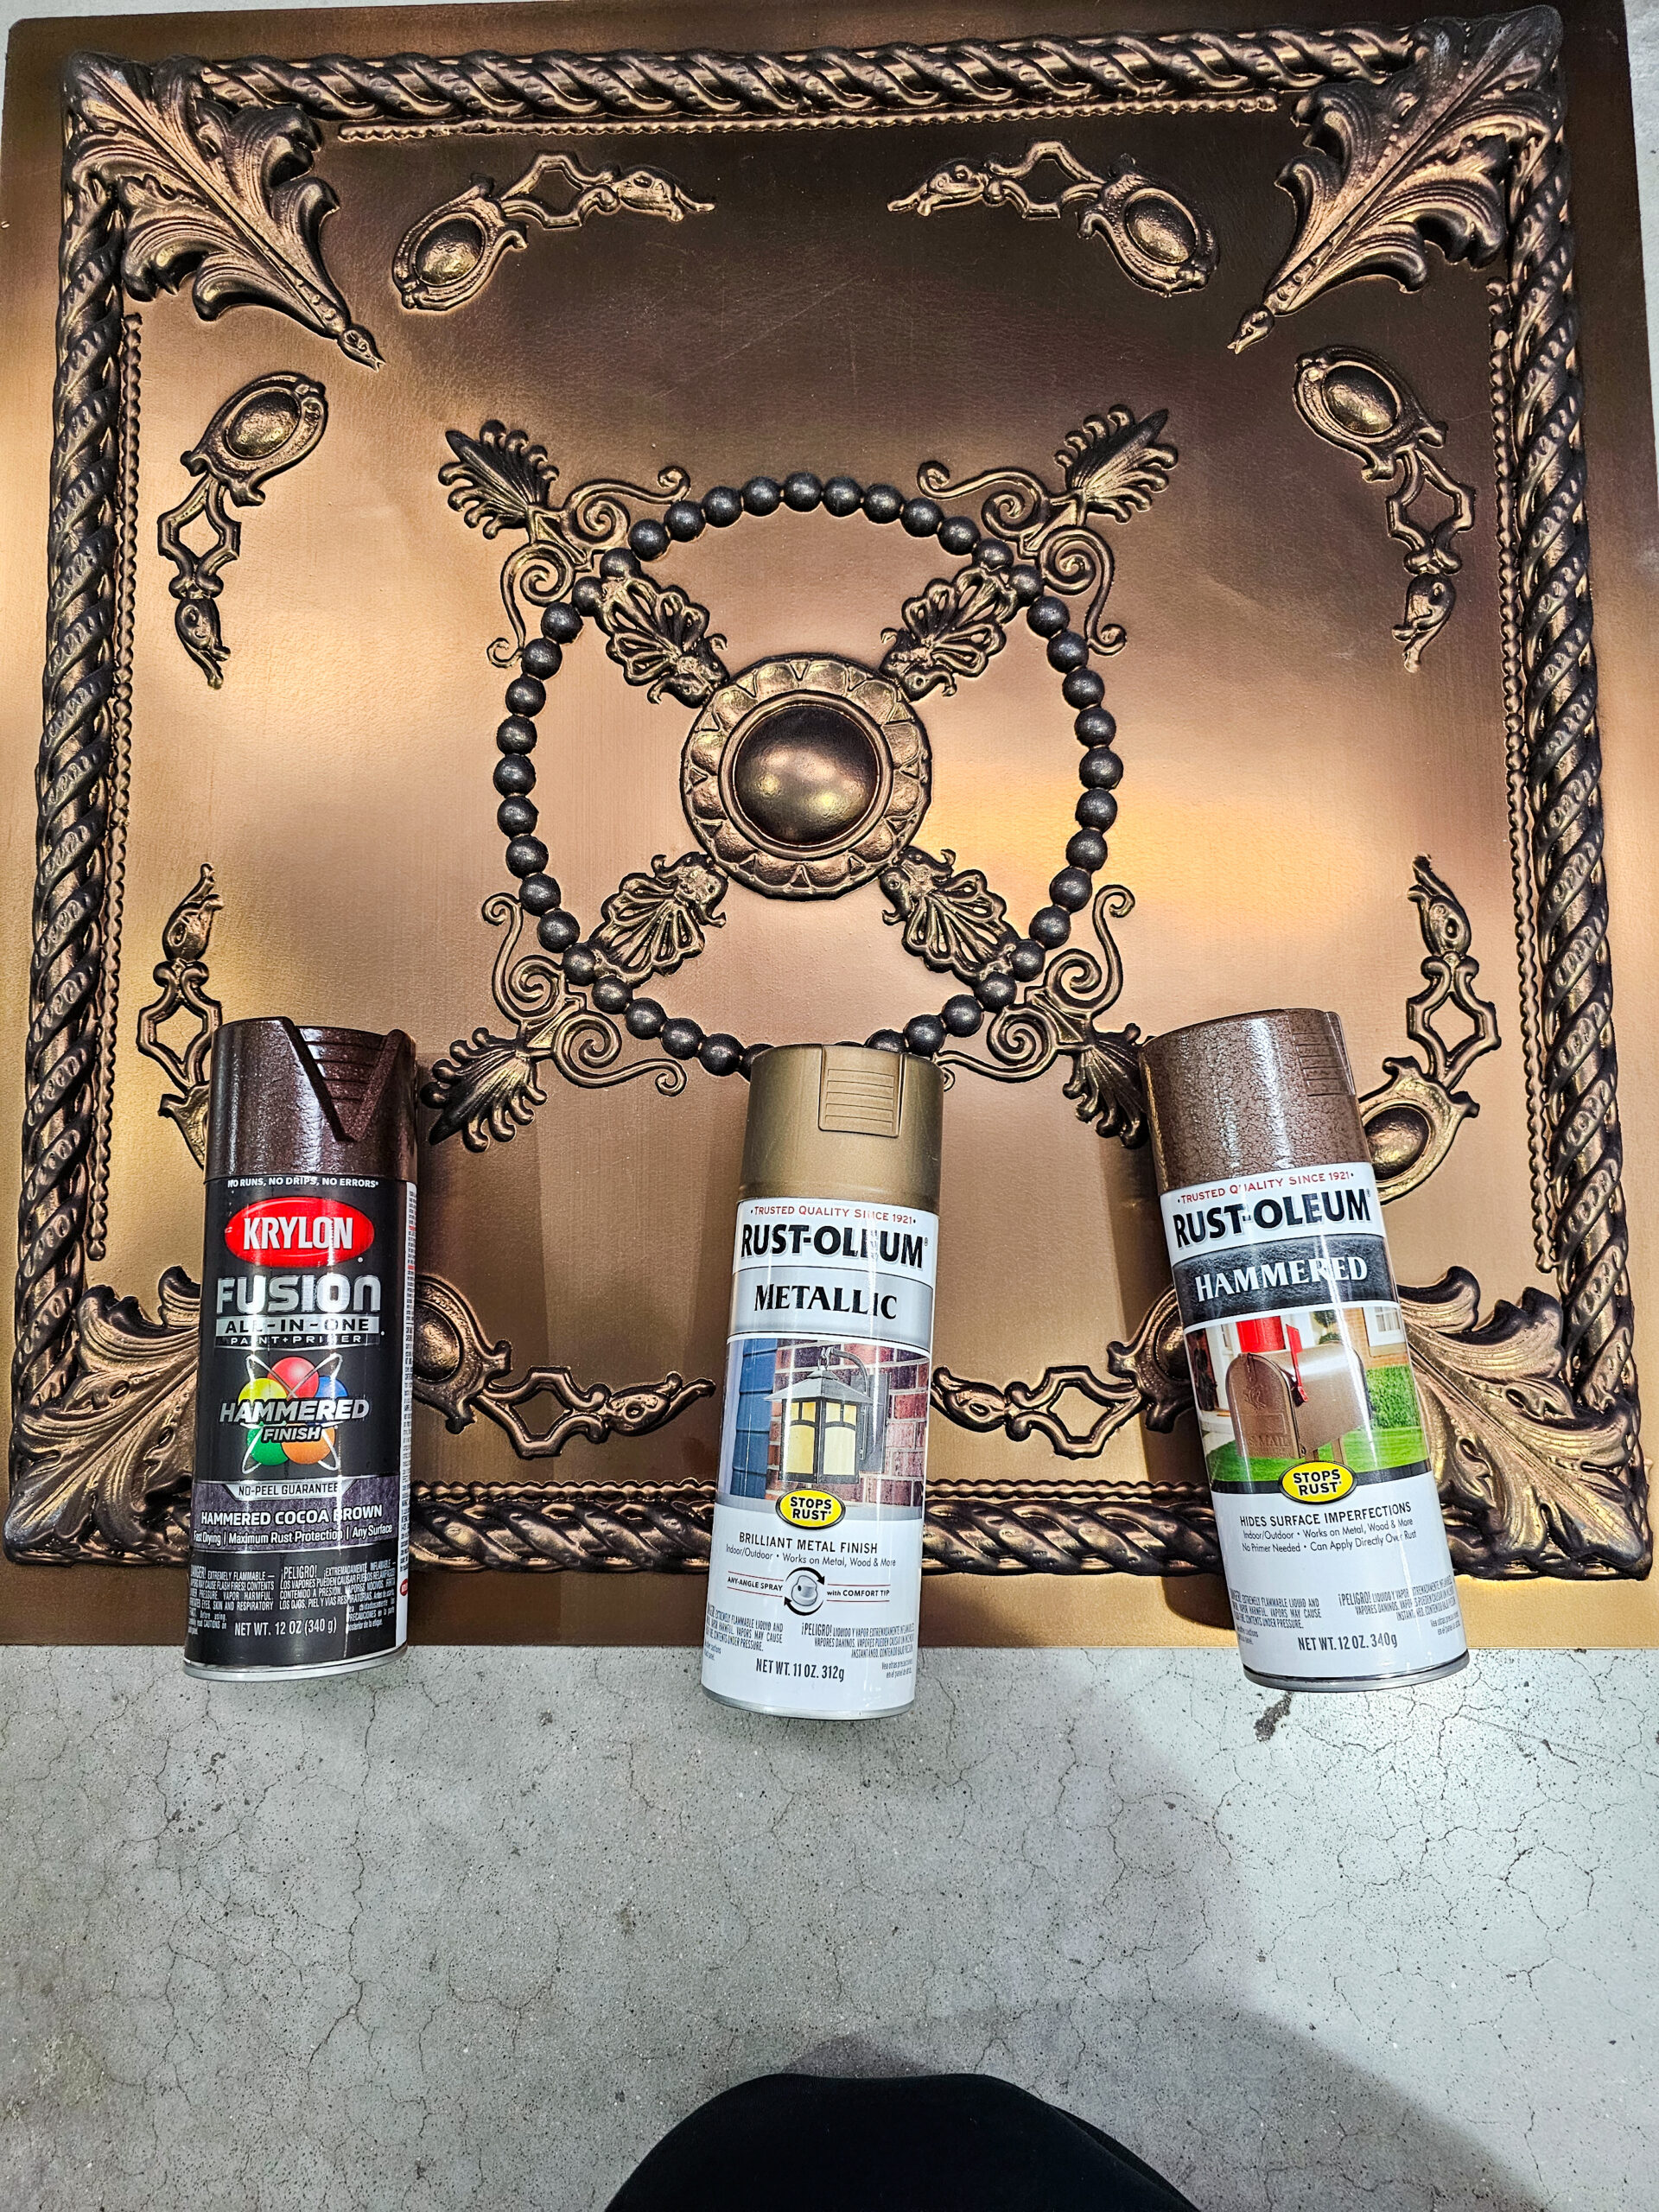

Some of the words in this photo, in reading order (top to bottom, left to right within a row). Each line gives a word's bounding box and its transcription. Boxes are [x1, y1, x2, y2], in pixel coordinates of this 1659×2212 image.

[227, 1179, 238, 1188] NO
[240, 1178, 266, 1187] RUNS,
[286, 1176, 320, 1185] DRIPS,
[1180, 1188, 1225, 1203] TRUSTED
[1289, 1173, 1325, 1185] SINCE
[1329, 1171, 1350, 1181] 1921
[754, 1206, 795, 1215] TRUSTED
[798, 1206, 850, 1217] QUALITY
[893, 1213, 912, 1224] 1921
[1173, 1189, 1370, 1248] RUST-OLEUM
[244, 1216, 353, 1249] KRYLON
[1194, 1256, 1367, 1302] HAMMERED
[216, 1274, 380, 1314] FUSION
[753, 1284, 897, 1319] METALLIC
[231, 1336, 361, 1346] PANT+PRIER
[219, 1399, 370, 1423] HAMMERED
[263, 1427, 321, 1441] FINISH
[1293, 1469, 1340, 1484] STOPS
[238, 1484, 278, 1497] NO-PEEL
[282, 1483, 337, 1495] GUARANTEE
[1298, 1481, 1338, 1497] RUST
[790, 1497, 831, 1510] STOPS
[201, 1510, 271, 1526] HAMMERED
[274, 1509, 329, 1525] COCOA
[333, 1504, 383, 1522] BROWN
[792, 1509, 826, 1521] RUST
[1239, 1516, 1267, 1528] HIDES
[1270, 1514, 1320, 1527] SURFACE
[1324, 1502, 1412, 1523] IMPERFECTIONS
[194, 1529, 202, 1542] Fast
[202, 1531, 221, 1546] Drying
[228, 1532, 268, 1544] Maximum
[270, 1531, 292, 1543] Rust
[295, 1529, 342, 1543] Protection
[353, 1527, 368, 1540] Any
[368, 1522, 392, 1536] Surface
[1243, 1529, 1294, 1540] Indoor/Outdoor
[1303, 1529, 1327, 1538] Works
[1342, 1524, 1365, 1535] Metal,
[1367, 1521, 1389, 1533] Wood
[1390, 1520, 1396, 1529] &
[1397, 1517, 1413, 1528] More
[740, 1531, 793, 1548] BRILLIANT
[797, 1540, 836, 1552] METAL
[840, 1542, 878, 1554] FINISH
[1242, 1543, 1250, 1552] No
[1251, 1542, 1270, 1552] Primer
[1272, 1543, 1300, 1552] Needed
[1310, 1541, 1327, 1552] Can
[1330, 1539, 1353, 1553] Apply
[1355, 1535, 1383, 1548] Directly
[1385, 1533, 1402, 1543] Over
[1403, 1529, 1417, 1541] Rust
[726, 1543, 772, 1559] Indoor/Outdoor
[783, 1552, 806, 1564] Works
[822, 1557, 847, 1567] Metal,
[850, 1557, 871, 1567] Wood
[873, 1557, 878, 1567] &
[880, 1558, 895, 1567] More
[207, 1571, 232, 1581] EXTREMELY
[233, 1571, 266, 1581] FLAMMABLE
[282, 1565, 318, 1582] ¡PELIGRO!
[216, 1581, 230, 1591] FLASH
[231, 1581, 246, 1591] FIRES!
[246, 1581, 275, 1591] CONTENTS
[280, 1580, 290, 1590] LOS
[292, 1579, 316, 1589] VAPORES
[316, 1578, 337, 1588] PUEDEN
[337, 1574, 356, 1586] CAUSAR
[728, 1576, 759, 1588] ANY-ANGLE
[760, 1582, 783, 1592] SPRAY
[223, 1591, 240, 1600] VAPOR
[280, 1590, 311, 1600] CONTENIDO
[313, 1590, 316, 1599] A
[1289, 1598, 1306, 1607] LIQUID
[1308, 1598, 1319, 1607] AND
[1338, 1592, 1372, 1606] ¡PELIGRO!
[1391, 1590, 1395, 1600] Y
[213, 1600, 223, 1611] SKIN
[225, 1600, 234, 1611] AND
[237, 1600, 273, 1611] RESPIRATORY
[280, 1600, 290, 1610] LOS
[308, 1599, 320, 1607] PIEL
[320, 1599, 325, 1607] Y
[1270, 1607, 1287, 1618] VAPORS
[1289, 1608, 1301, 1618] MAY
[1303, 1608, 1322, 1618] CAUSE
[1355, 1605, 1377, 1616] VAPORES
[235, 1622, 251, 1636] NET
[254, 1622, 271, 1636] WT.
[275, 1621, 285, 1635] 12
[289, 1619, 302, 1635] OZ
[304, 1618, 325, 1636] (340
[328, 1617, 337, 1634] g)
[755, 1619, 771, 1631] LIQUID
[772, 1623, 783, 1633] AND
[802, 1623, 832, 1637] ¡PELIGRO!
[852, 1628, 855, 1637] Y
[855, 1628, 869, 1637] VAPOR
[1277, 1618, 1304, 1628] PRESSURE.
[736, 1626, 752, 1638] VAPORS
[754, 1630, 764, 1640] MAY
[766, 1631, 783, 1643] CAUSE
[814, 1637, 835, 1647] VAPORES
[857, 1637, 874, 1648] VAPORES
[1298, 1637, 1316, 1650] NET
[1319, 1637, 1337, 1650] WT.
[1338, 1637, 1350, 1650] 12
[1351, 1635, 1369, 1649] OZ.
[1370, 1632, 1397, 1649] 340g
[740, 1638, 764, 1651] PRESSURE.
[756, 1658, 774, 1674] NET
[776, 1661, 790, 1676] WT.
[793, 1662, 802, 1676] 11
[804, 1664, 819, 1678] OZ.
[821, 1665, 845, 1683] 312g
